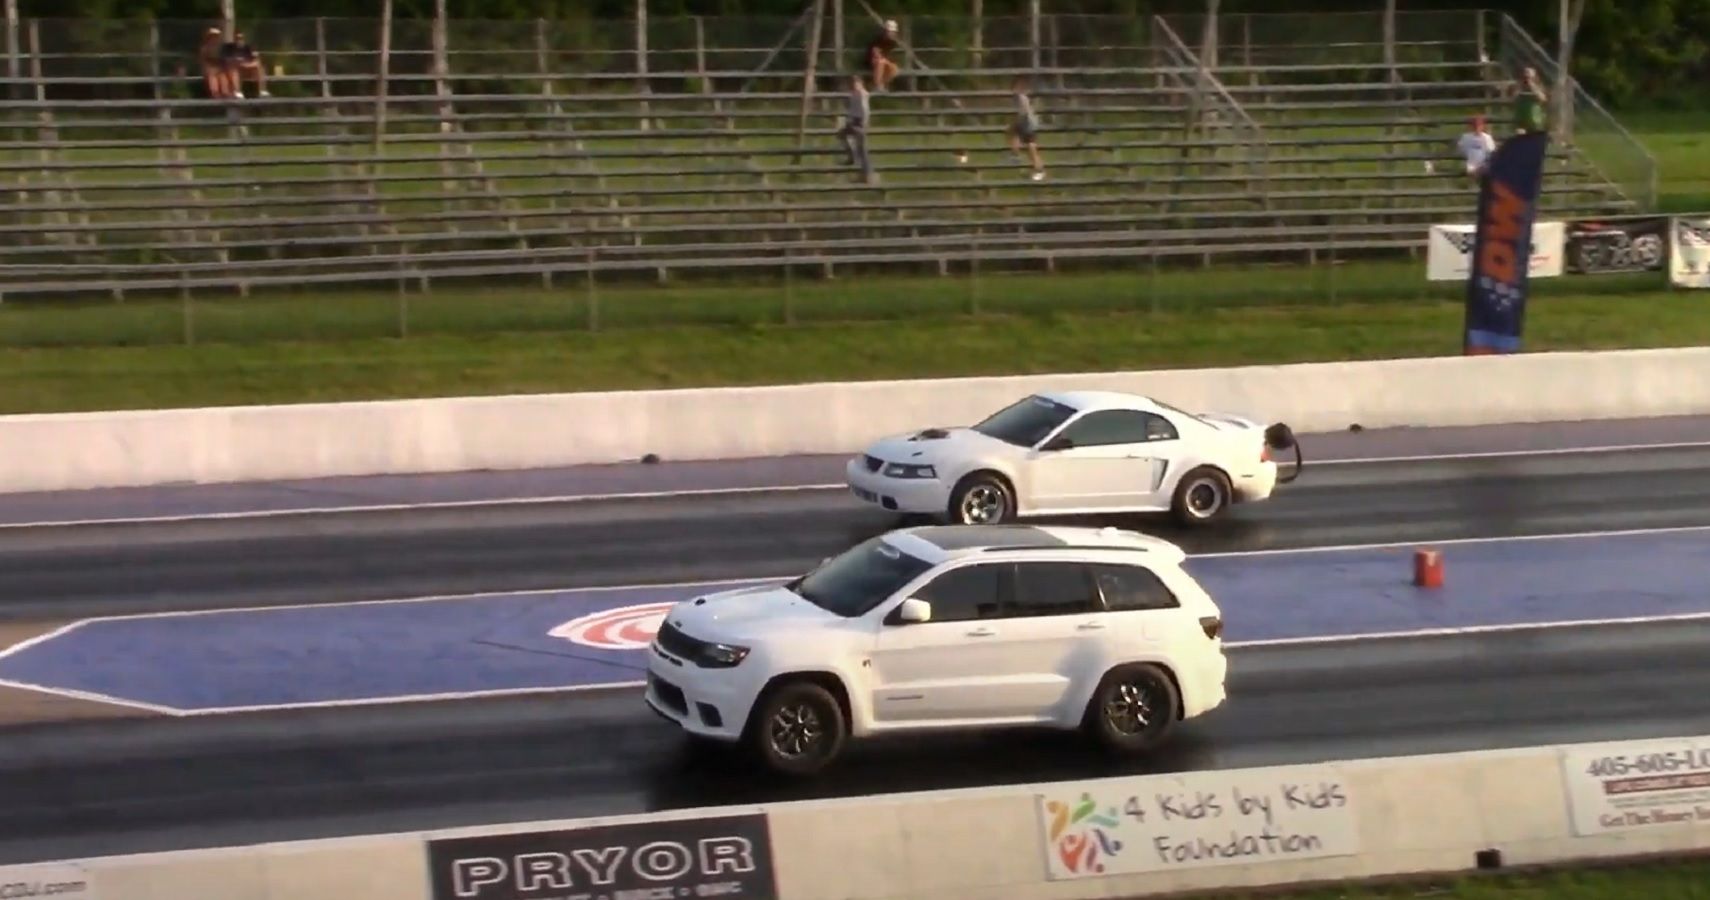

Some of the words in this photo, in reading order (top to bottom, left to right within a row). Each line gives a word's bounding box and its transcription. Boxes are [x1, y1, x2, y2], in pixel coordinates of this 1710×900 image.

[1123, 796, 1145, 823] 4
[1154, 792, 1223, 821] Kids
[1232, 786, 1273, 825] by
[1281, 782, 1348, 810] Kids
[1153, 823, 1323, 864] Foundation
[452, 836, 756, 897] PRYOR
